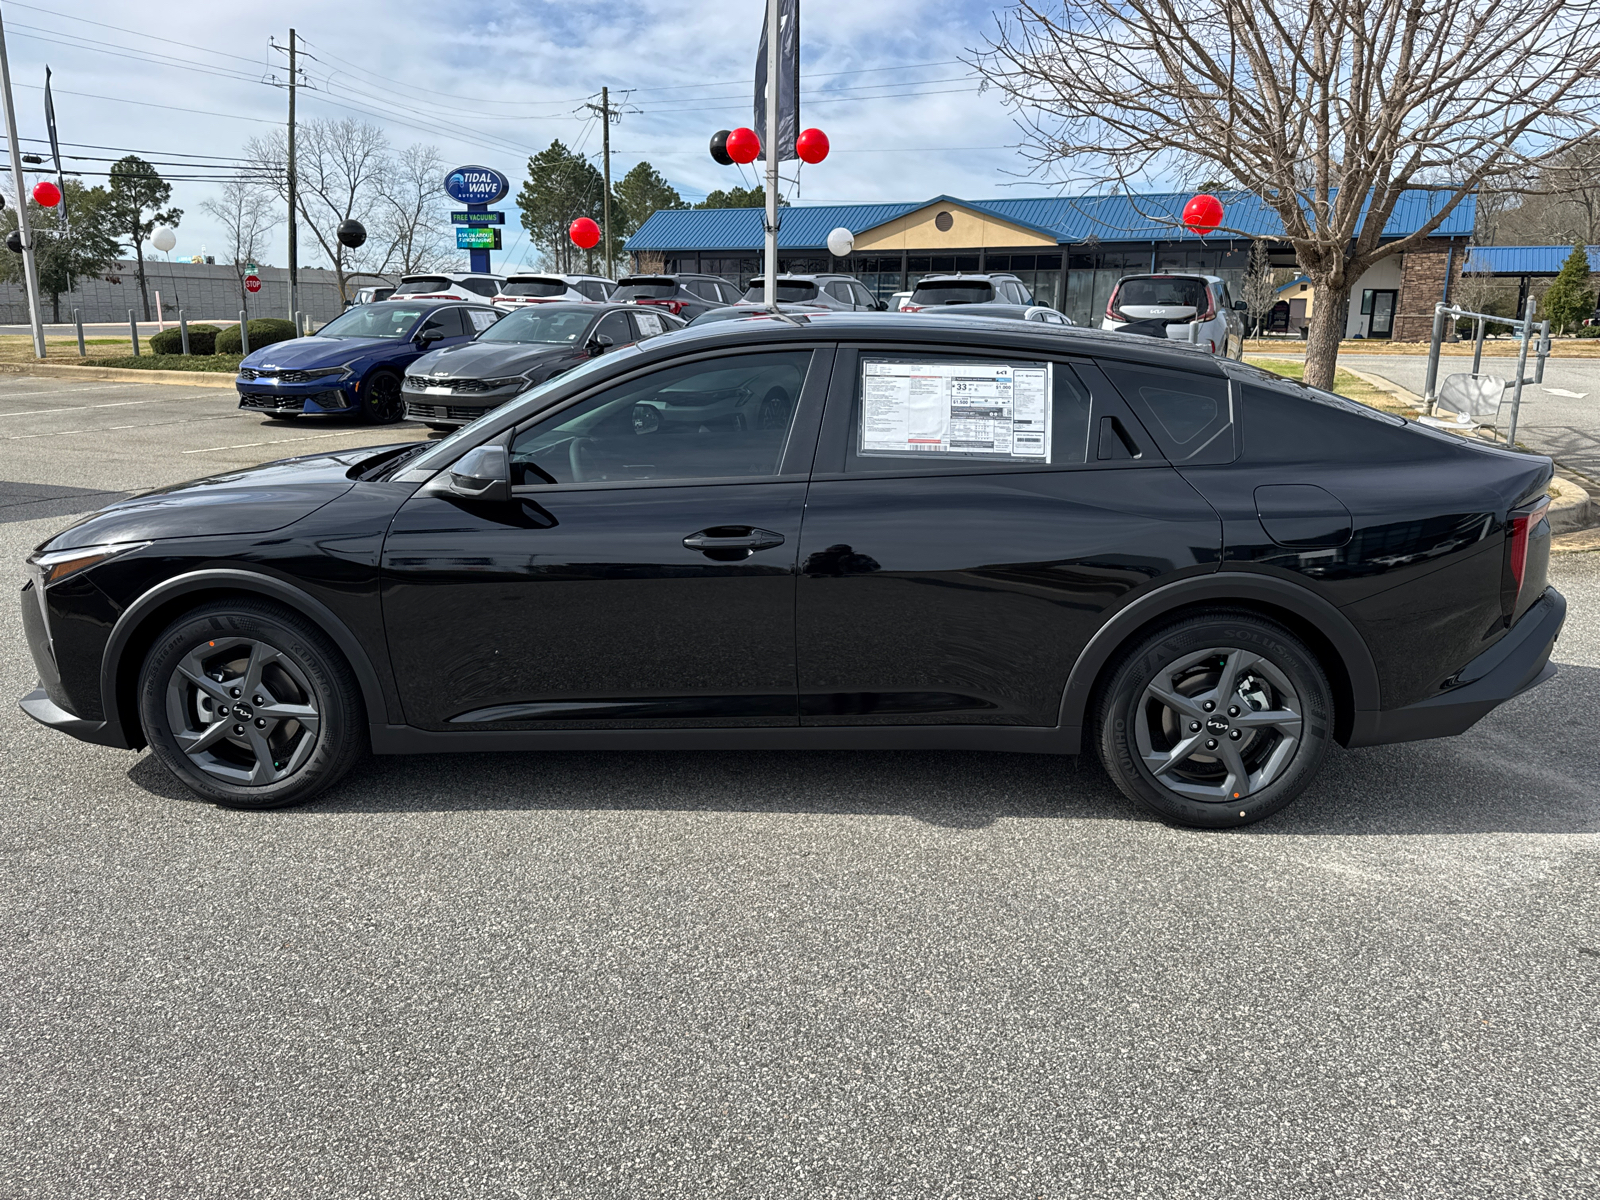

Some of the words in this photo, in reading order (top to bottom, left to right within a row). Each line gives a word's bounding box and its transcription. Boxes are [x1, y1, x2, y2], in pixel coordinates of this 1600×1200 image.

[464, 173, 491, 182] TIDAL
[469, 183, 497, 192] WAVE
[246, 280, 261, 288] STOP
[956, 383, 967, 391] 33
[1223, 629, 1287, 655] SOLUS
[147, 666, 159, 697] 205/55
[156, 650, 169, 666] R16
[168, 635, 184, 651] 91H
[289, 641, 331, 696] KUMHO
[1114, 718, 1140, 781] KUMHO
